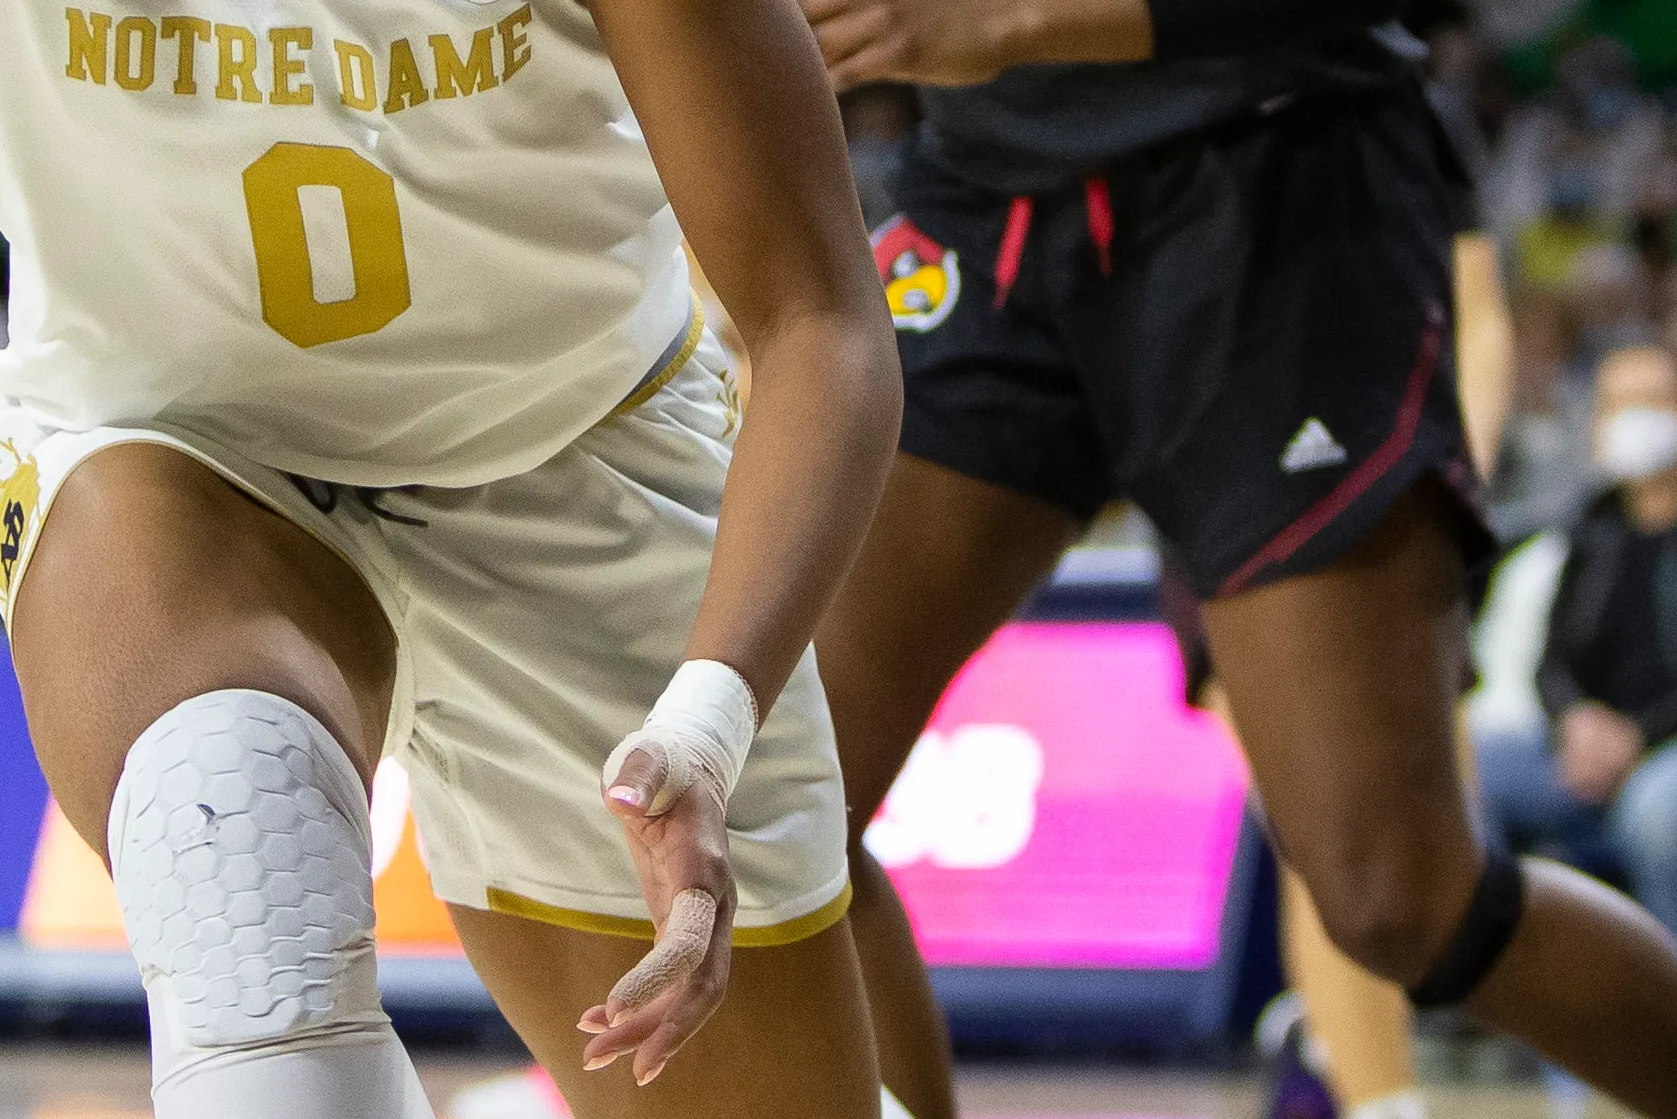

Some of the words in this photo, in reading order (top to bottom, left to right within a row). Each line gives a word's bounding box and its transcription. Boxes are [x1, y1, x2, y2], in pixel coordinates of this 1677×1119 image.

[65, 6, 314, 108] NOTRE
[334, 3, 533, 115] DAME
[241, 140, 412, 350] 0
